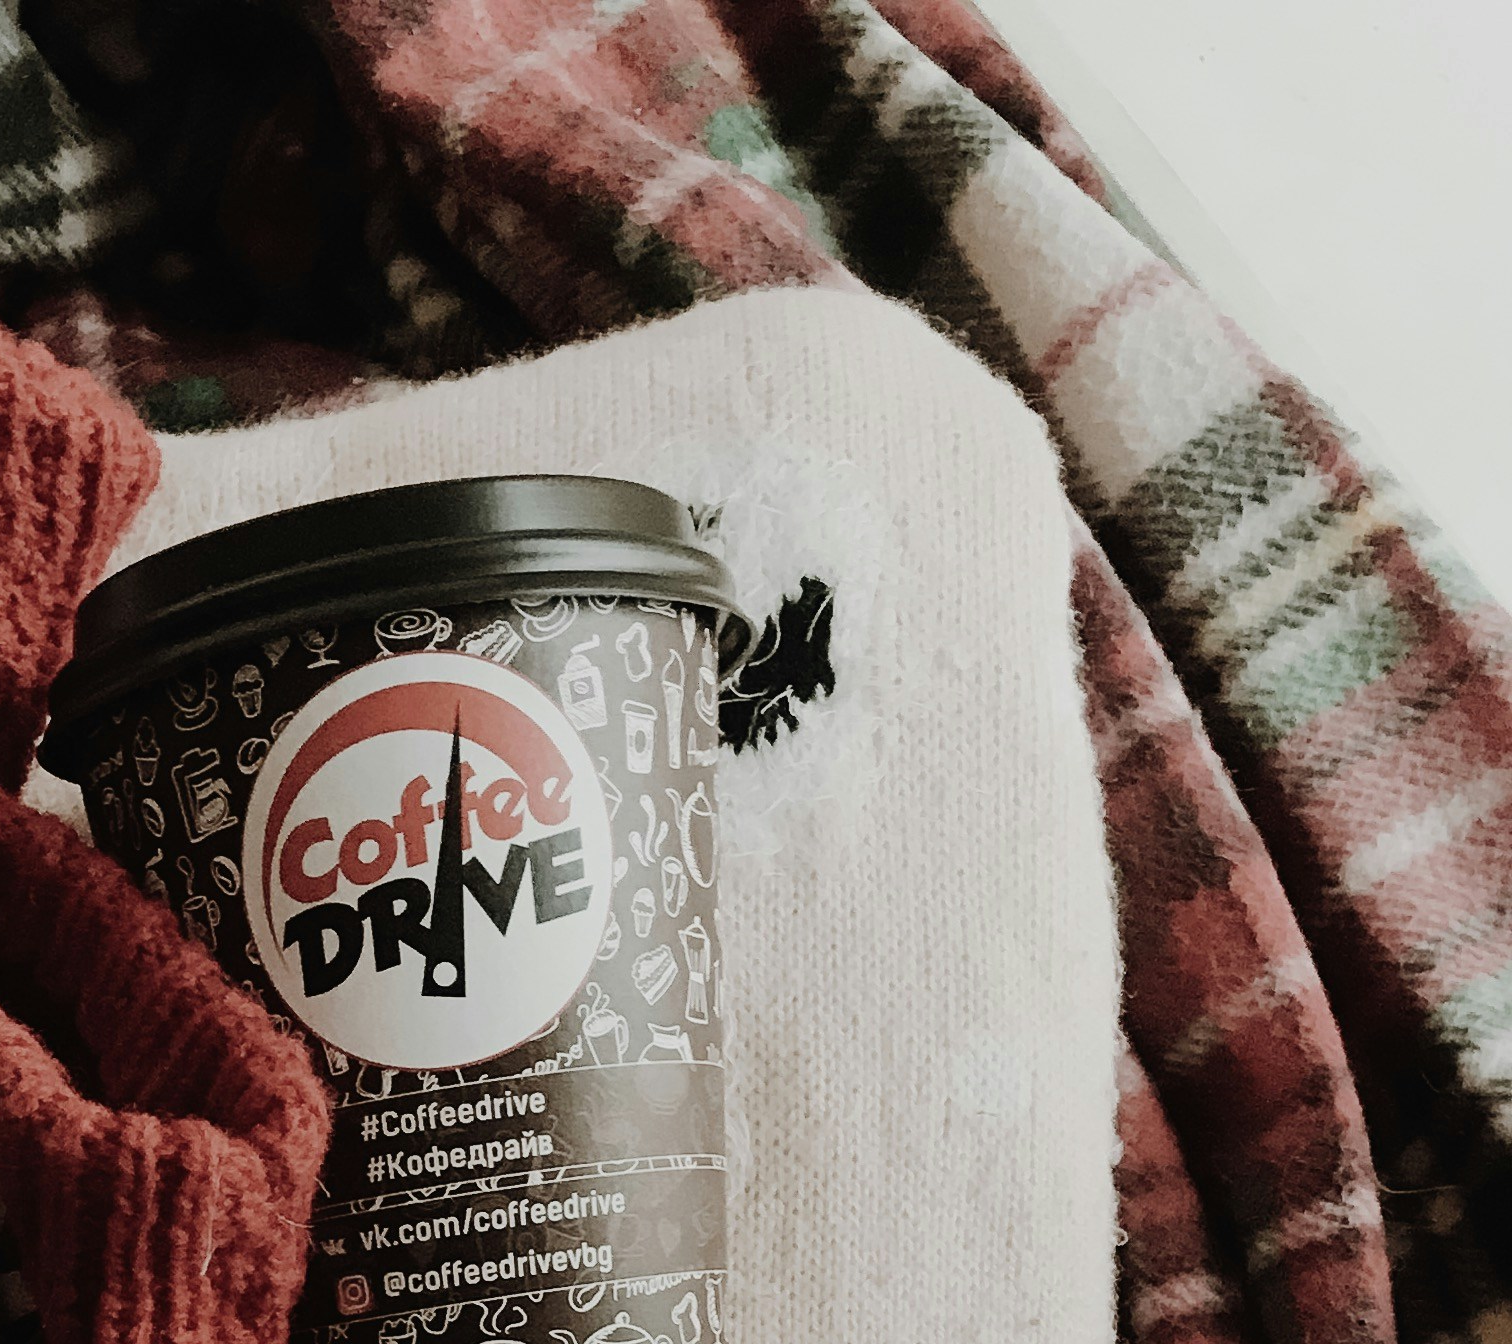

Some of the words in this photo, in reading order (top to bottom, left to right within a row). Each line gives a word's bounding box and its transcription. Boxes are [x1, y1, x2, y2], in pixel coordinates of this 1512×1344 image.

[279, 761, 574, 904] Coffee
[282, 827, 594, 998] DRIVE
[361, 1089, 546, 1141] #Coffeedrive
[367, 1131, 553, 1183] #Кофедрайв
[360, 1189, 626, 1252] vk.com/coffeedrive
[384, 1243, 614, 1298] @coffeedrivevbg
